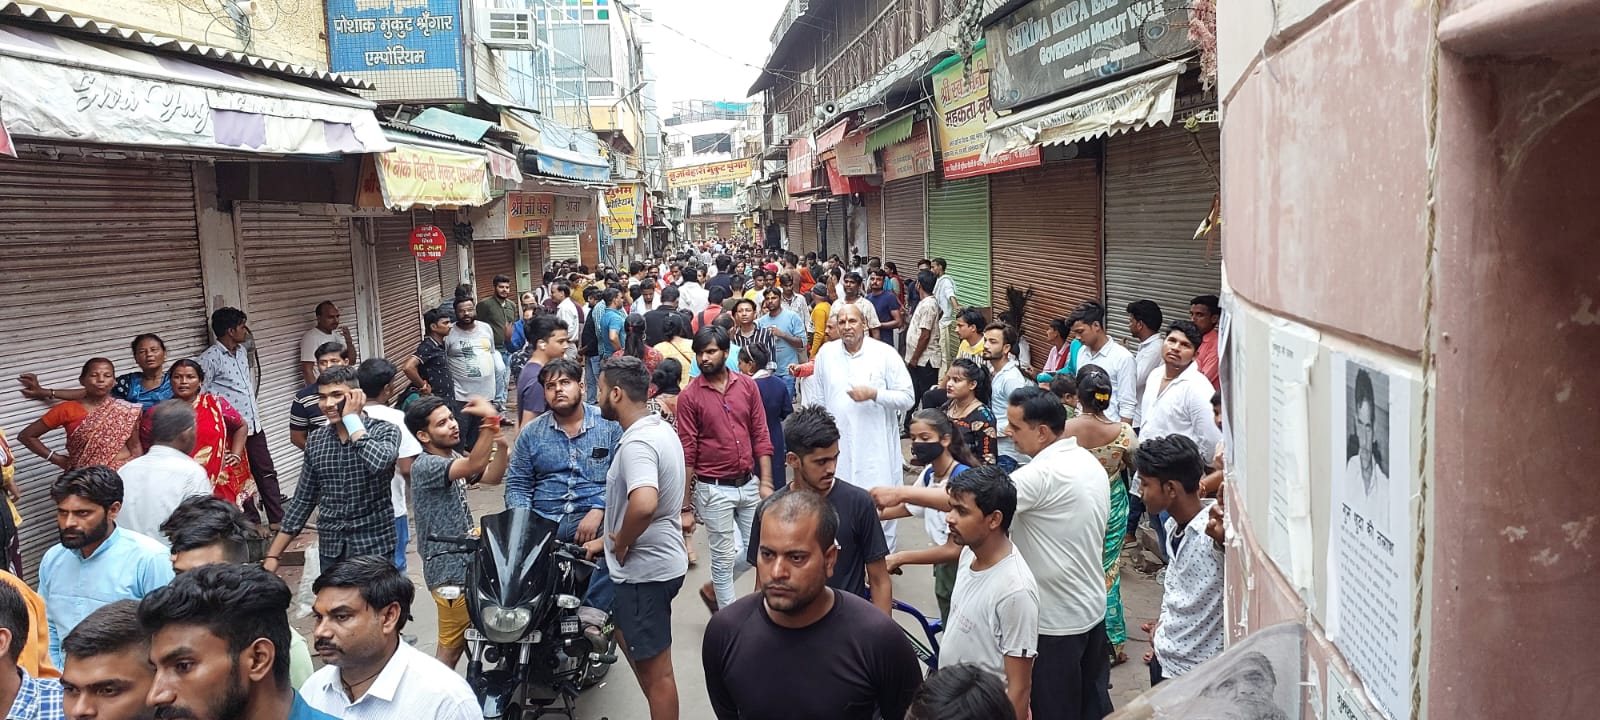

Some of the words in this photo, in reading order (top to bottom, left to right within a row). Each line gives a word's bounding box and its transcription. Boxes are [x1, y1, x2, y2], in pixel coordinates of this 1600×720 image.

[334, 15, 376, 33] पोशाक
[379, 16, 414, 39] मुकुट
[1051, 1, 1090, 35] KRIPA
[1090, 12, 1127, 45] MUKUT
[364, 44, 426, 66] एम्पोरियम
[1366, 519, 1375, 540] की
